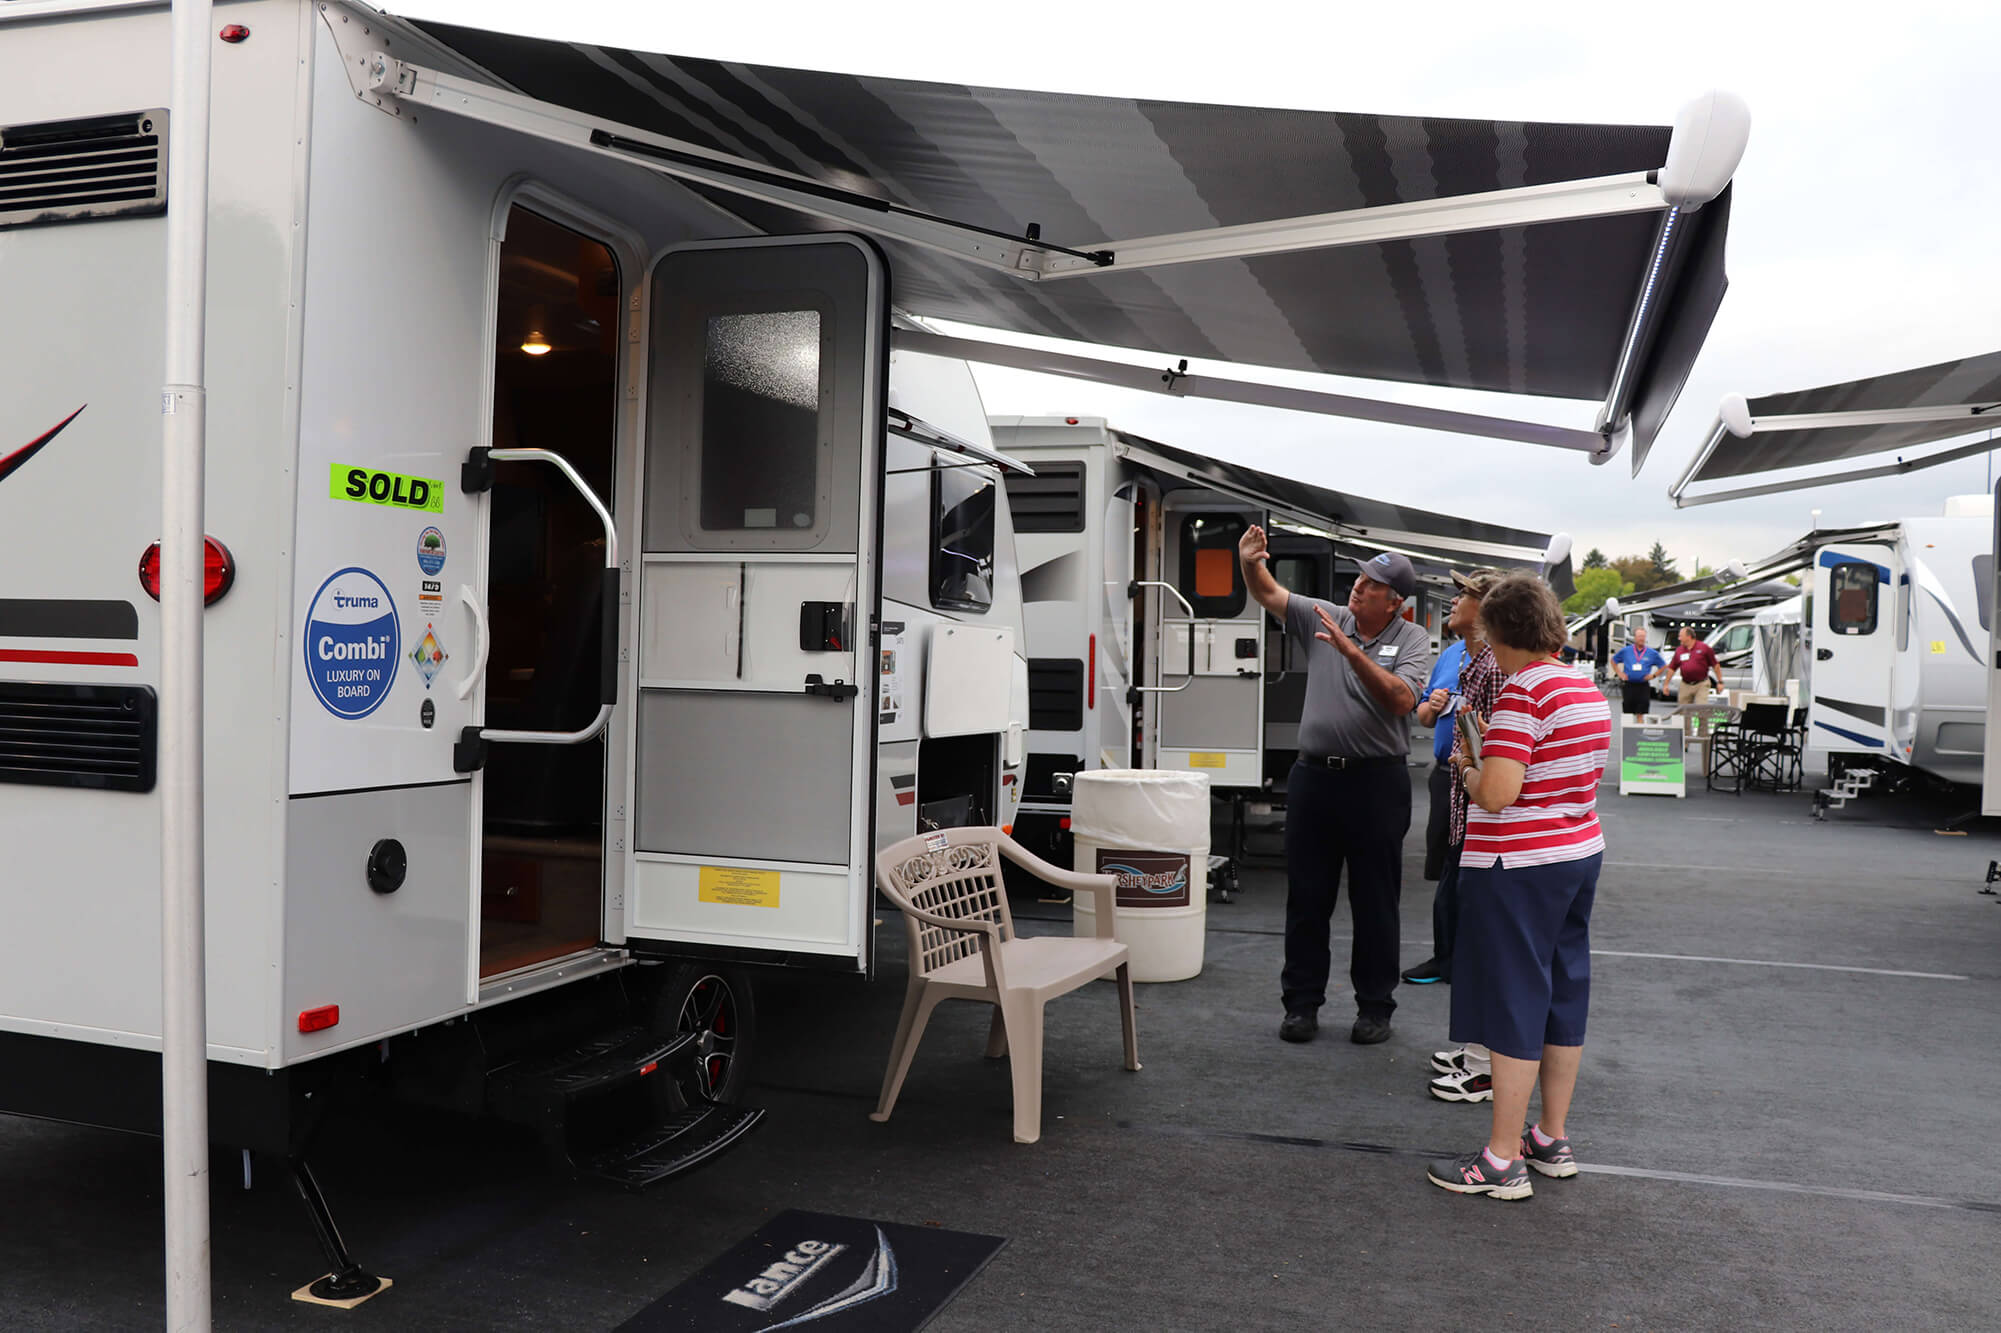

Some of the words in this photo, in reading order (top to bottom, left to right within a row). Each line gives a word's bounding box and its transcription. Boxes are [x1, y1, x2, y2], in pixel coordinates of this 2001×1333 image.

[346, 469, 429, 506] SOLD
[333, 591, 379, 609] truma
[326, 669, 365, 683] LUXURY
[366, 669, 381, 681] ON
[337, 685, 371, 698] BOARD
[1103, 869, 1176, 889] RSHEYPARK
